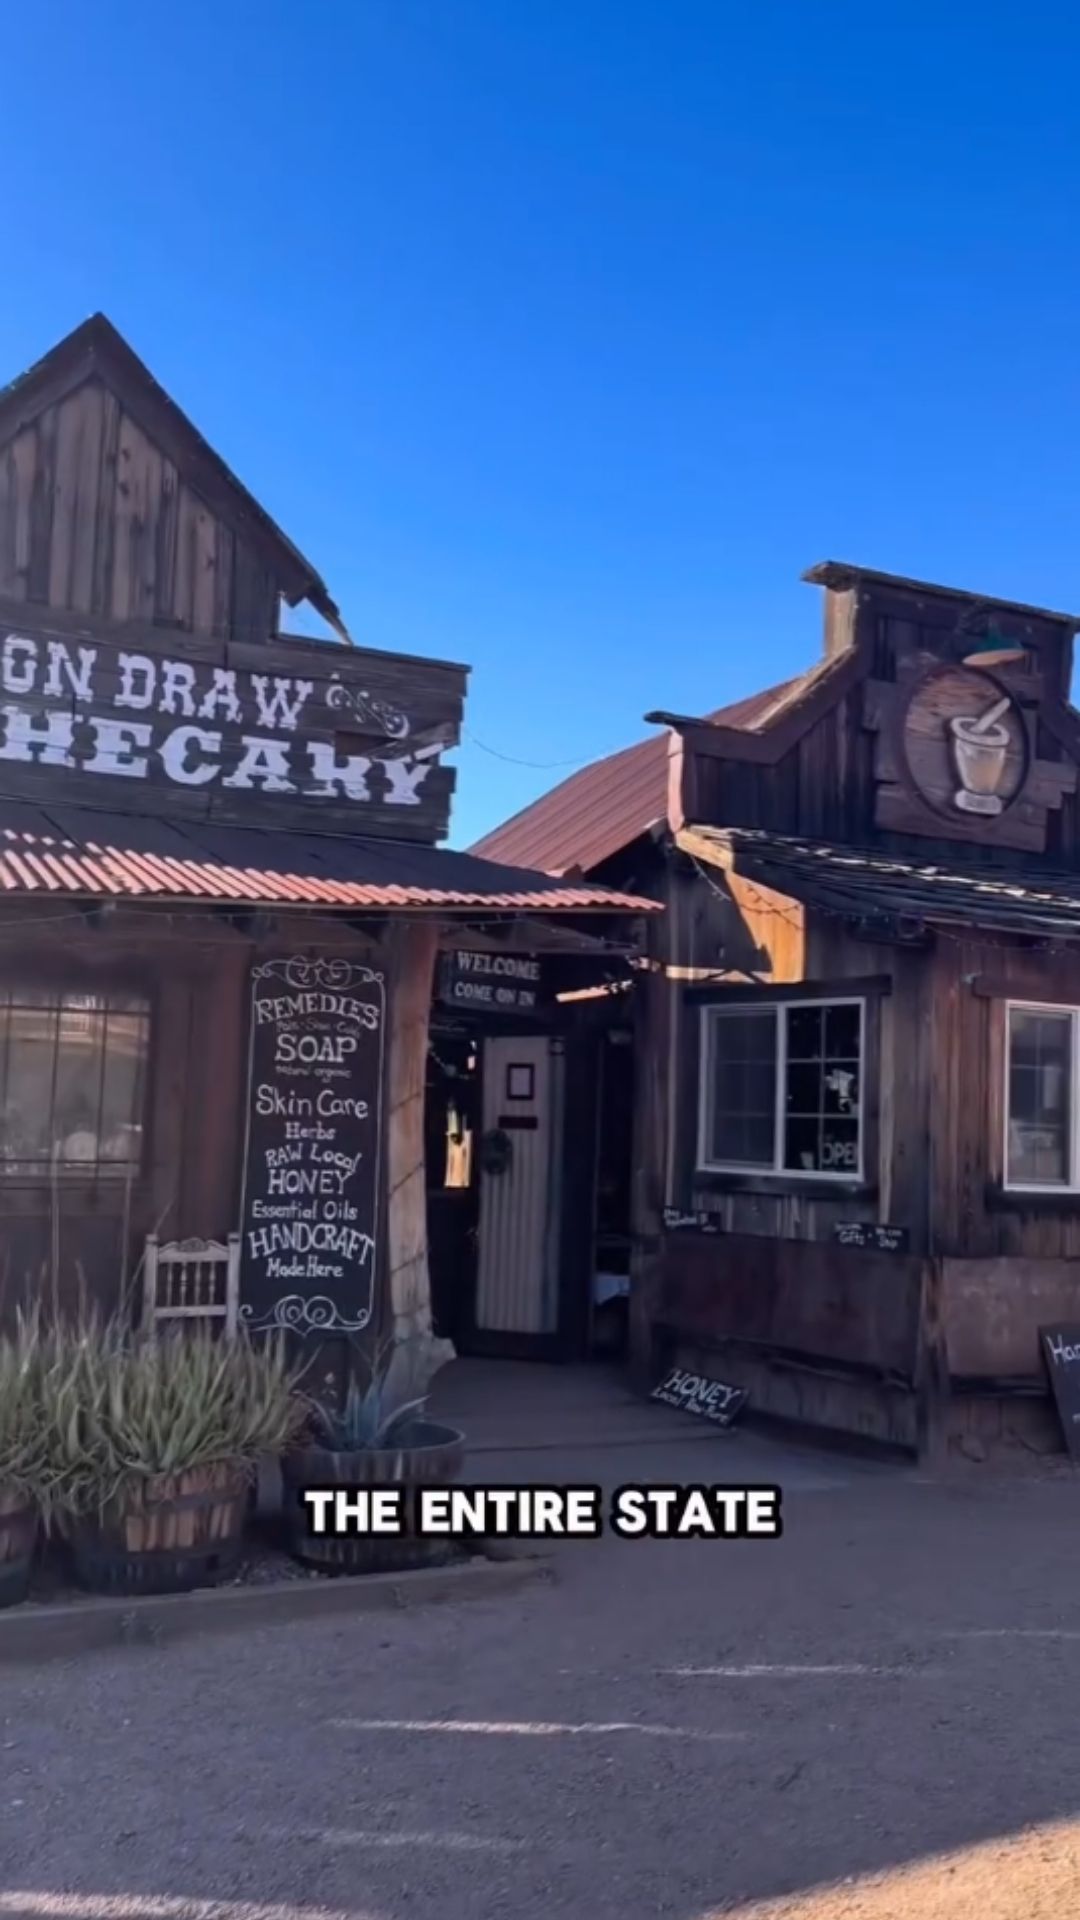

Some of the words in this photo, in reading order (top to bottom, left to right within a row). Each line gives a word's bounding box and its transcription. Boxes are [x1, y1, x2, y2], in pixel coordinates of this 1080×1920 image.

[2, 634, 97, 703] ON
[114, 652, 313, 730] DRAW
[457, 951, 540, 980] WELCOME
[454, 981, 493, 1002] COME
[496, 988, 516, 1003] ON
[518, 990, 536, 1006] IN
[254, 993, 379, 1030] REMEDIES
[274, 1033, 358, 1063] SOAP
[256, 1084, 312, 1116] Skin
[316, 1090, 368, 1118] Care
[285, 1121, 336, 1140] Herbs
[265, 1142, 303, 1168] RAW
[310, 1143, 362, 1173] Local
[821, 1142, 858, 1165] OPE
[267, 1168, 352, 1195] HONEY
[252, 1200, 317, 1219] Essential
[323, 1200, 358, 1220] Oils
[249, 1222, 375, 1265] HANDCRAFT
[266, 1256, 304, 1277] Made
[305, 1255, 344, 1277] Here
[664, 1370, 741, 1408] HONEY
